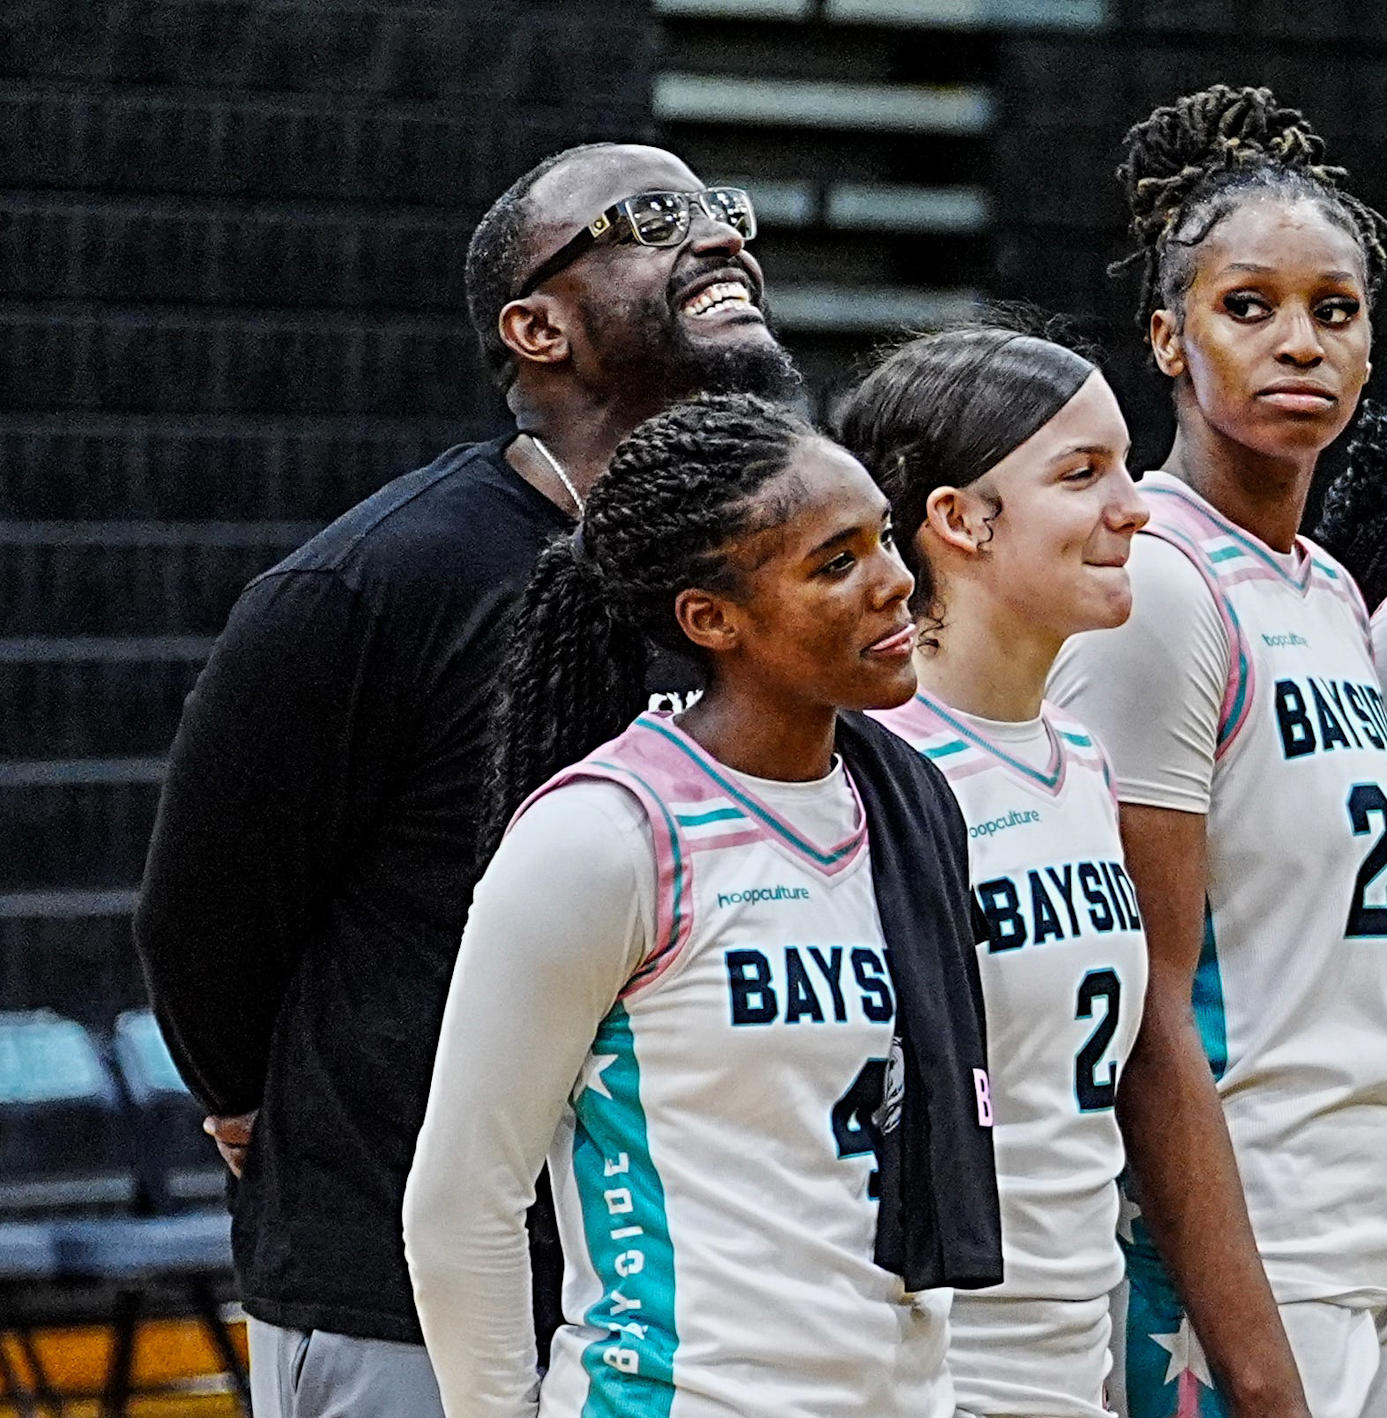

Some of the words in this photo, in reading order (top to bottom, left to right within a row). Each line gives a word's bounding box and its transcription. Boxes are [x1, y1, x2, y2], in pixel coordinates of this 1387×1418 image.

[969, 809, 1040, 838] oopculture
[717, 885, 810, 909] hoopculture
[977, 862, 1142, 955] BAYSID
[724, 946, 897, 1027] BAYS
[1075, 967, 1122, 1113] 2
[829, 1057, 890, 1202] 4
